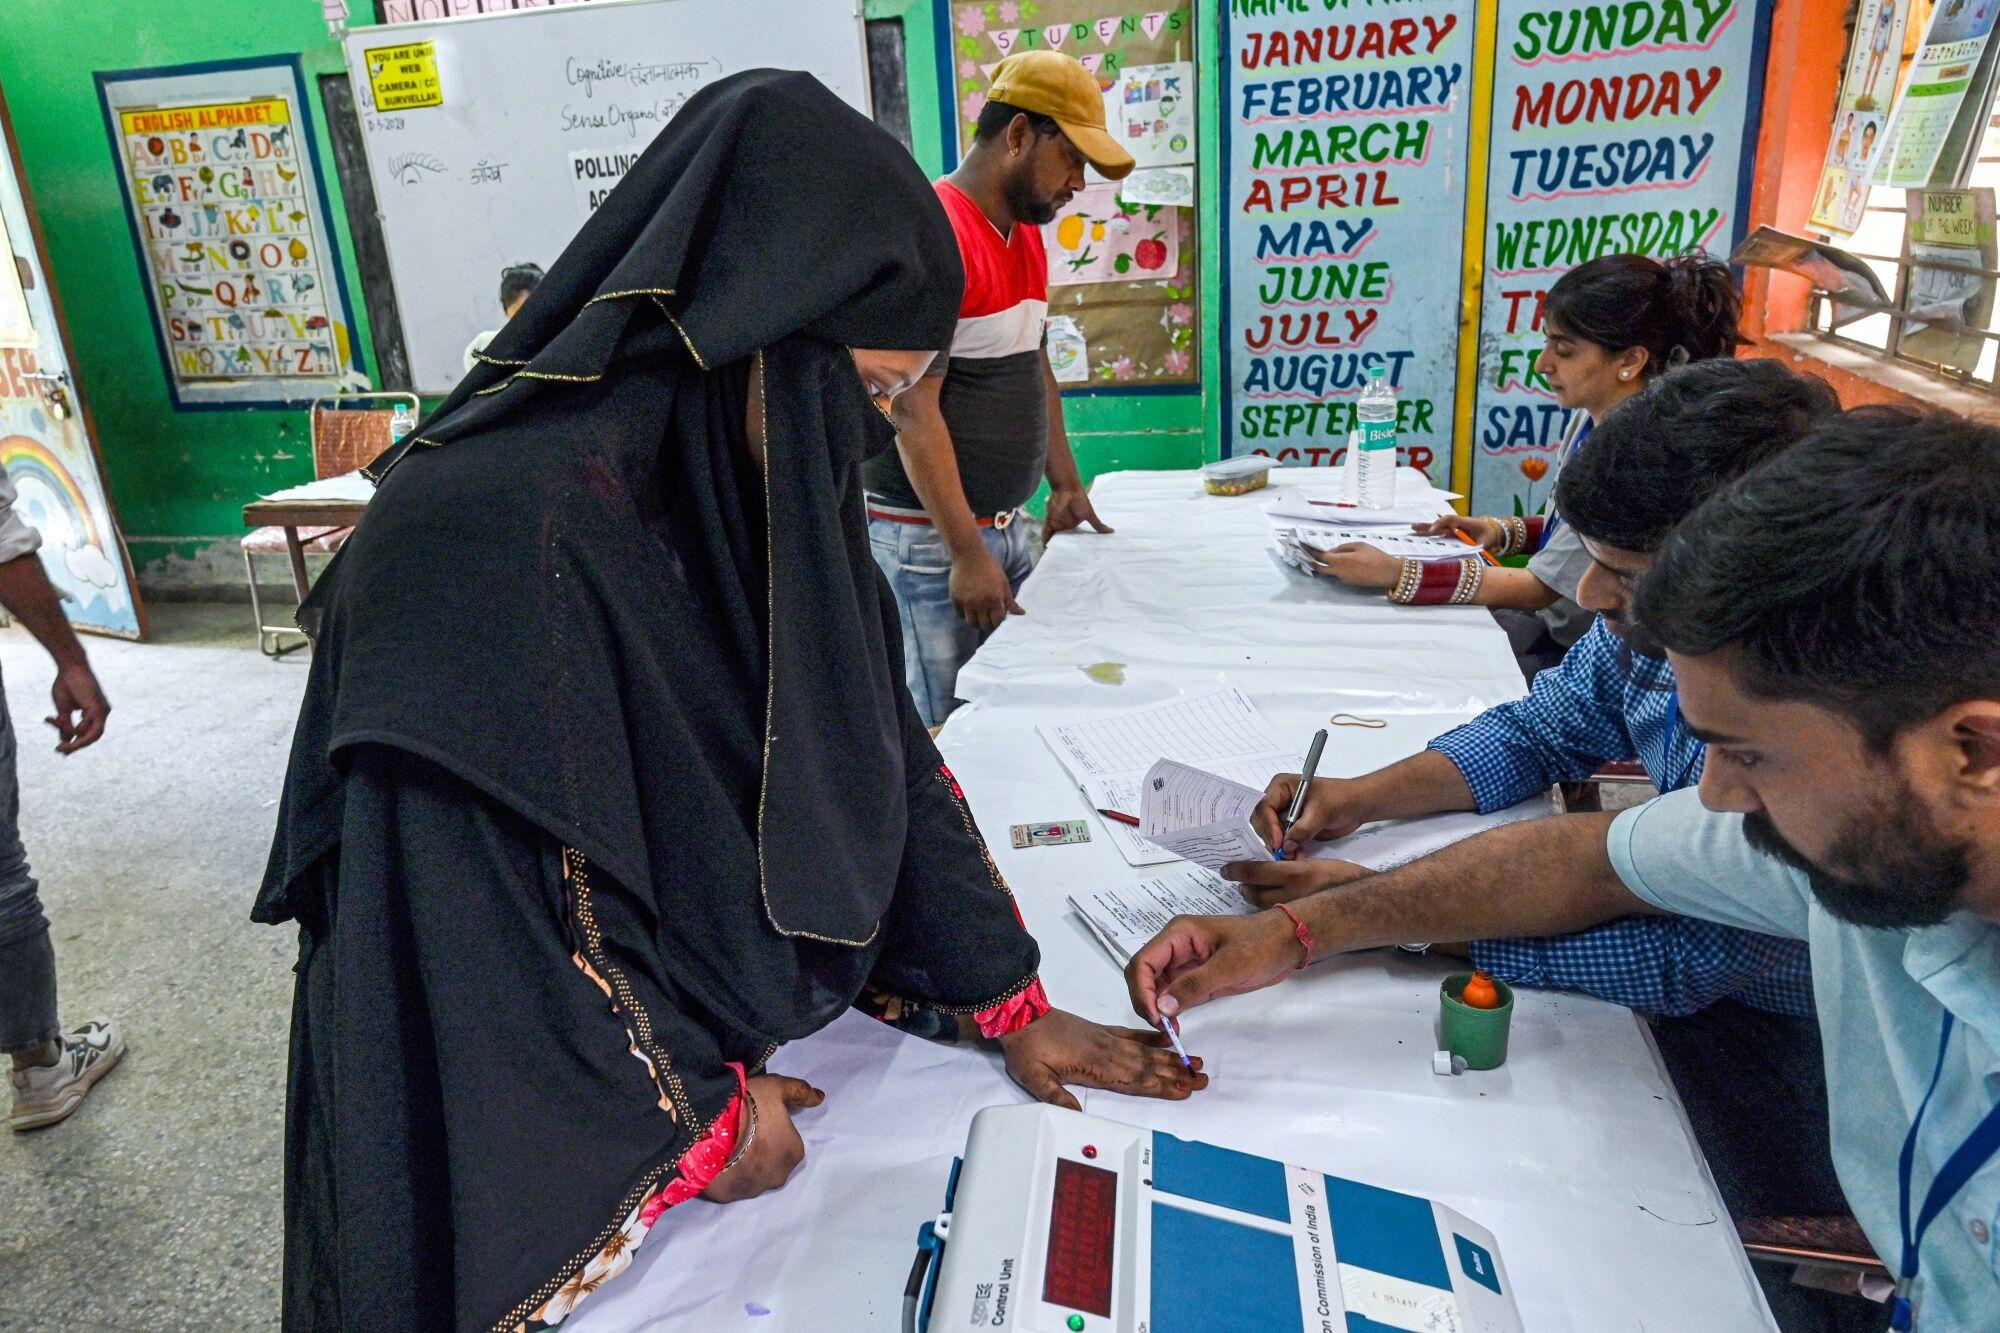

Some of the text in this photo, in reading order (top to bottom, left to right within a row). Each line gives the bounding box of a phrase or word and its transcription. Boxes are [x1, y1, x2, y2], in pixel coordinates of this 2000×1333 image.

[1241, 14, 1457, 70] JANUARY
[1513, 0, 1732, 60] SUNDAY
[372, 53, 391, 63] YOU
[394, 50, 410, 60] ARE
[400, 64, 421, 74] WEB
[378, 81, 417, 93] CAMERA
[1243, 63, 1462, 119] FEBRUARY
[1512, 66, 1722, 132] MONDAY
[133, 104, 272, 133] ENGLISH ALPHABET
[561, 104, 608, 131] Sense
[169, 139, 188, 164] B
[212, 135, 232, 161] C
[250, 133, 271, 159] D
[1252, 119, 1429, 170] MARCH
[1510, 132, 1714, 197] TUESDAY
[178, 176, 193, 201] F
[219, 172, 240, 198] G
[1243, 170, 1399, 214] APRIL
[260, 243, 282, 268] O
[1257, 218, 1374, 259] MAY
[1496, 207, 1719, 271] WEDNESDAY
[215, 281, 237, 307] Q
[1259, 262, 1389, 304] JUNE
[207, 317, 227, 341] T
[1245, 308, 1378, 349] JULY
[1243, 351, 1414, 396] AUGUST
[1240, 399, 1434, 438] SEPTEER
[1370, 428, 1395, 441] Bisle
[1142, 1147, 1150, 1165] Busy
[1306, 1204, 1317, 1231] India
[1310, 1231, 1320, 1245] of
[991, 1258, 1014, 1327] Control Unit
[1311, 1245, 1330, 1317] Commission
